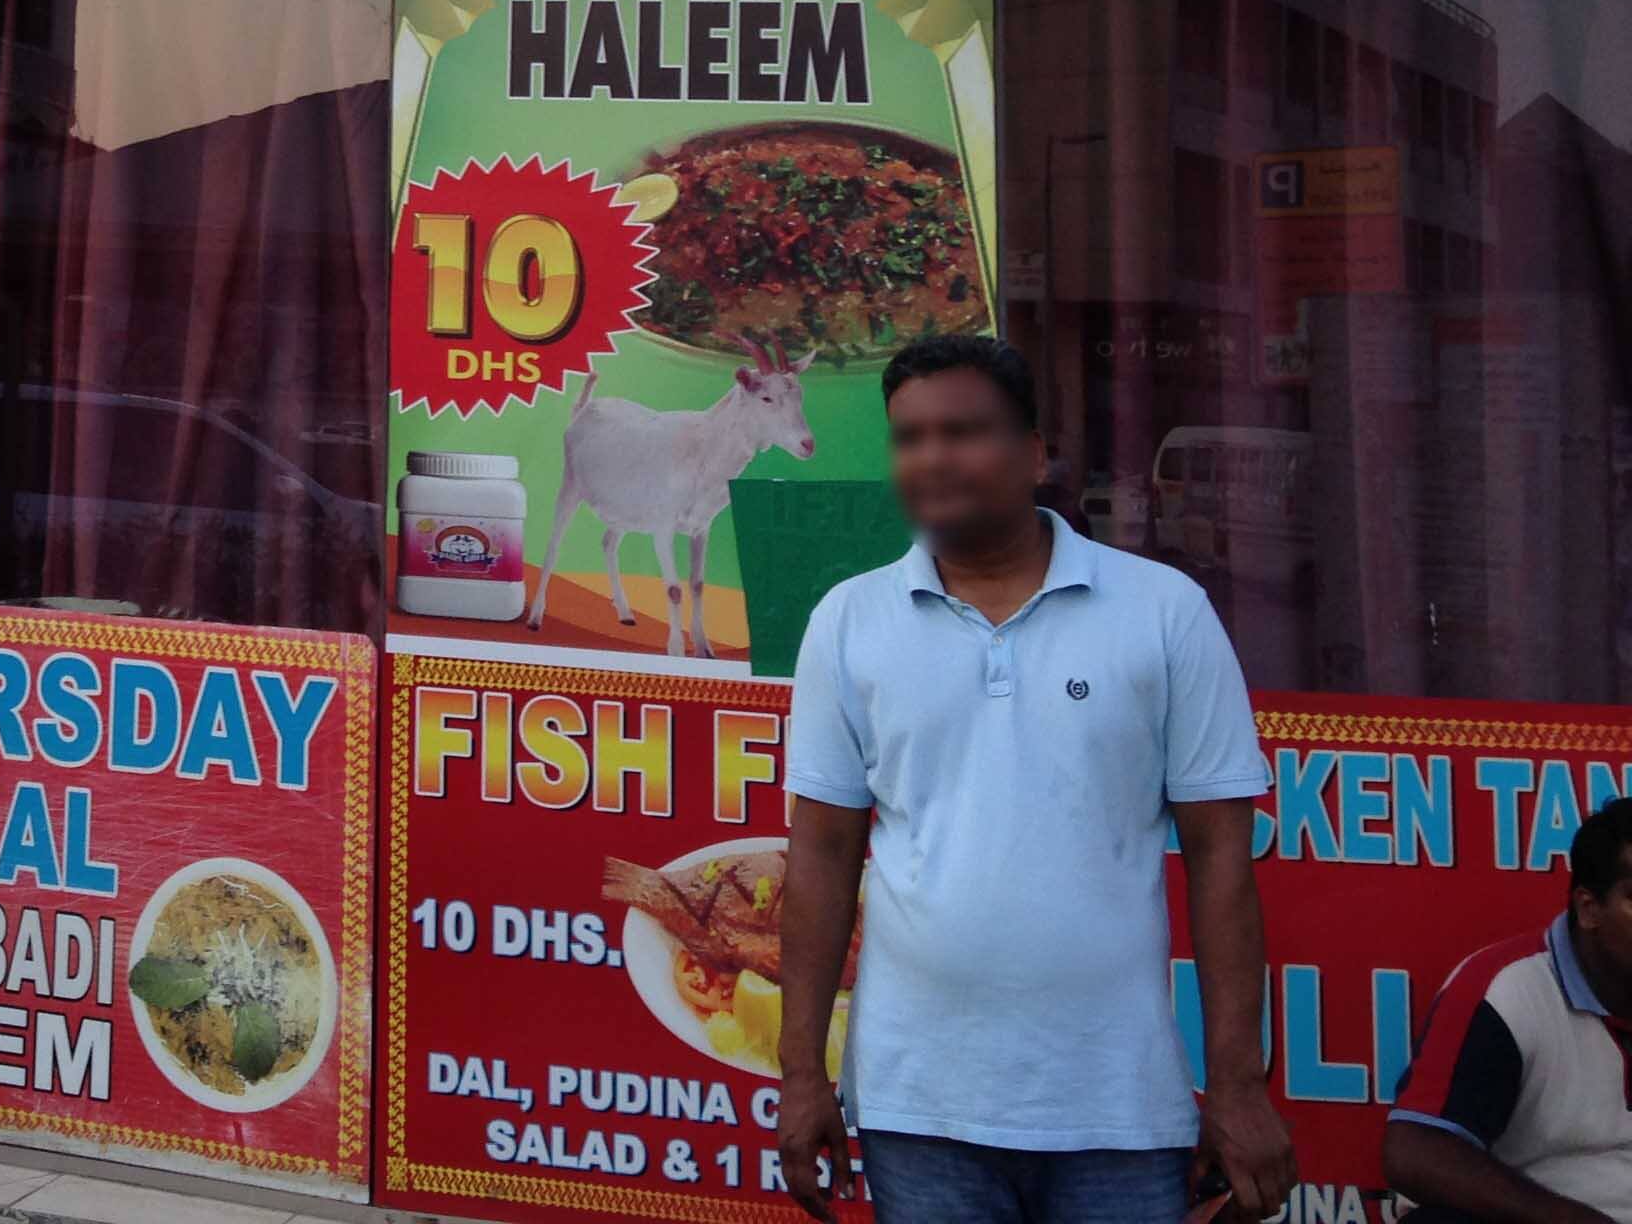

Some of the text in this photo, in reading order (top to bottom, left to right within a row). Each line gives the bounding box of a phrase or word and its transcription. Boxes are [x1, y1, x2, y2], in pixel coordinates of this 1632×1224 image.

[412, 213, 585, 342] 10
[446, 349, 542, 384] DHS
[414, 686, 672, 818] FISH
[411, 897, 623, 969] 10 DHS.
[428, 1052, 534, 1113] DAL,
[548, 1065, 738, 1126] PUDINA
[485, 1119, 647, 1177] SALAD
[662, 1143, 700, 1184] &
[716, 1143, 741, 1188] 1
